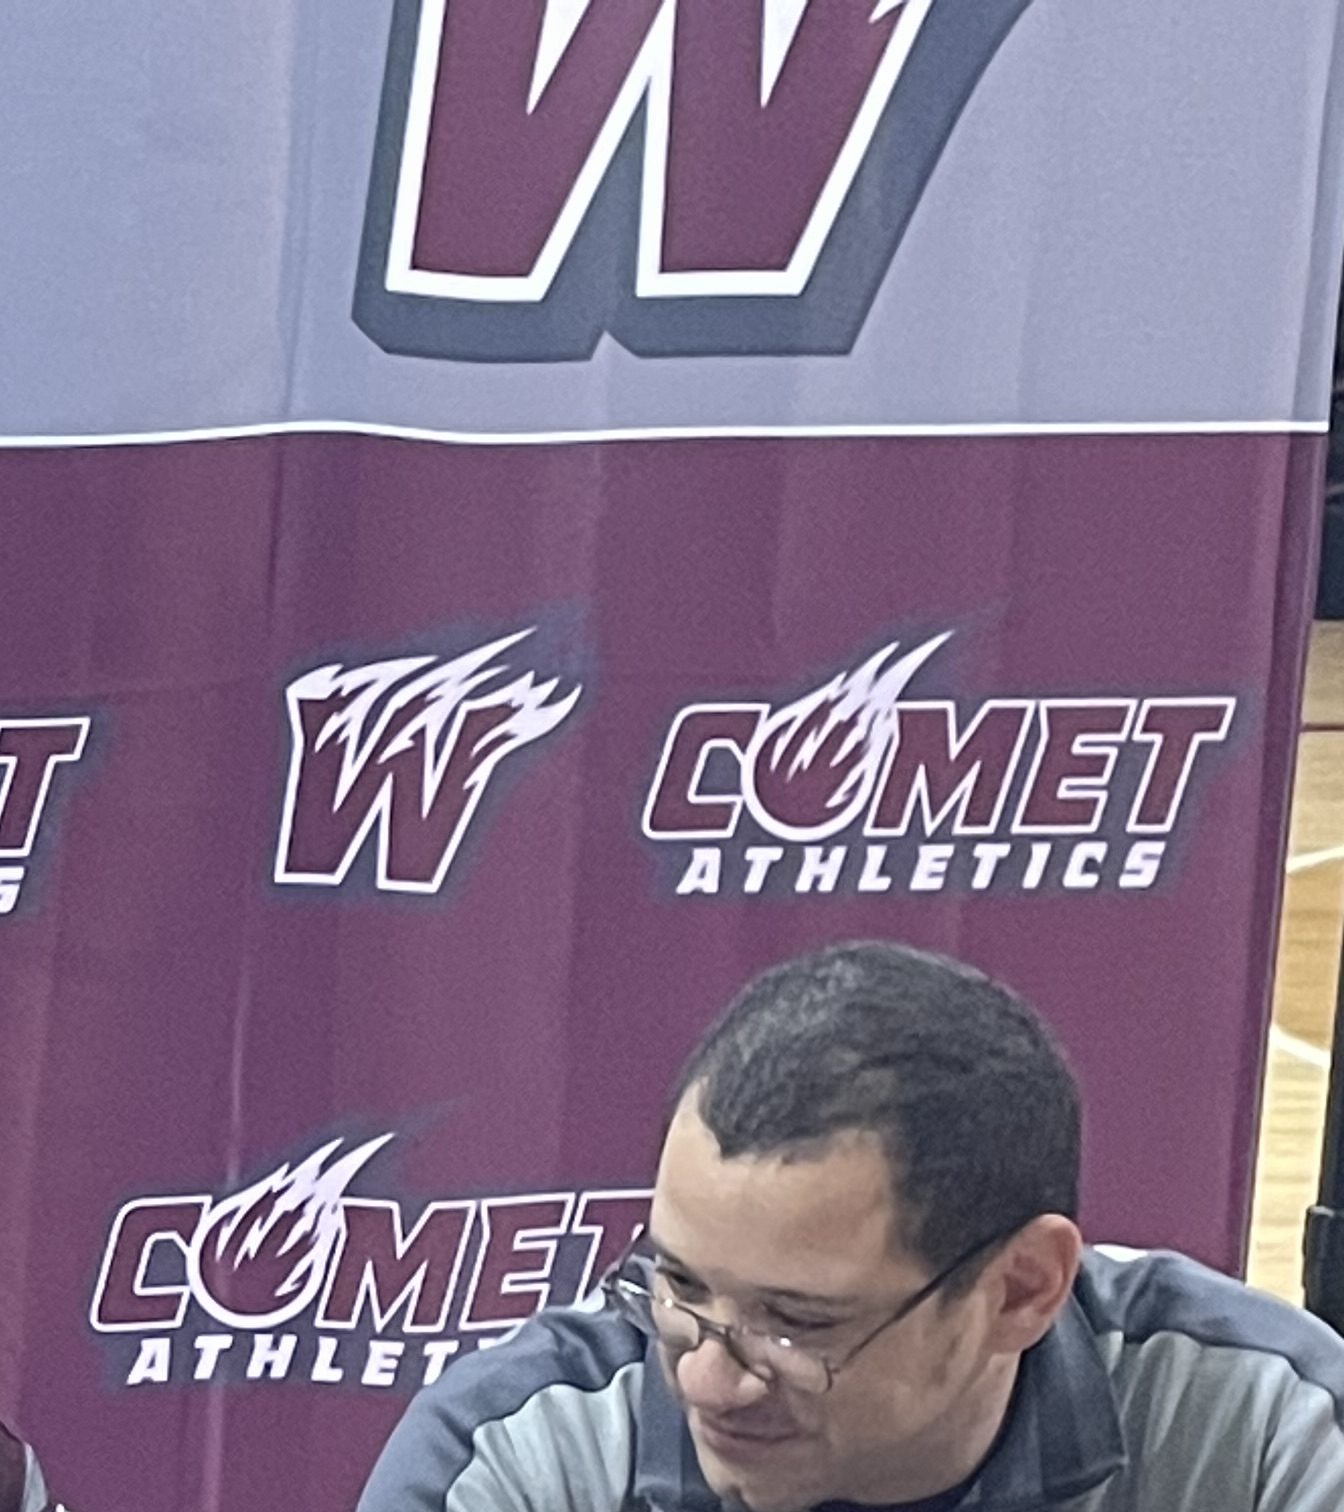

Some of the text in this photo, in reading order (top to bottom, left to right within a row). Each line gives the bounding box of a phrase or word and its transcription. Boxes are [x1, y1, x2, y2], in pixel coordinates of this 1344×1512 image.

[274, 625, 583, 894] W
[641, 630, 1238, 842] COMET
[675, 841, 1167, 895] ATHLETICS
[126, 1333, 498, 1387] ATHLET
